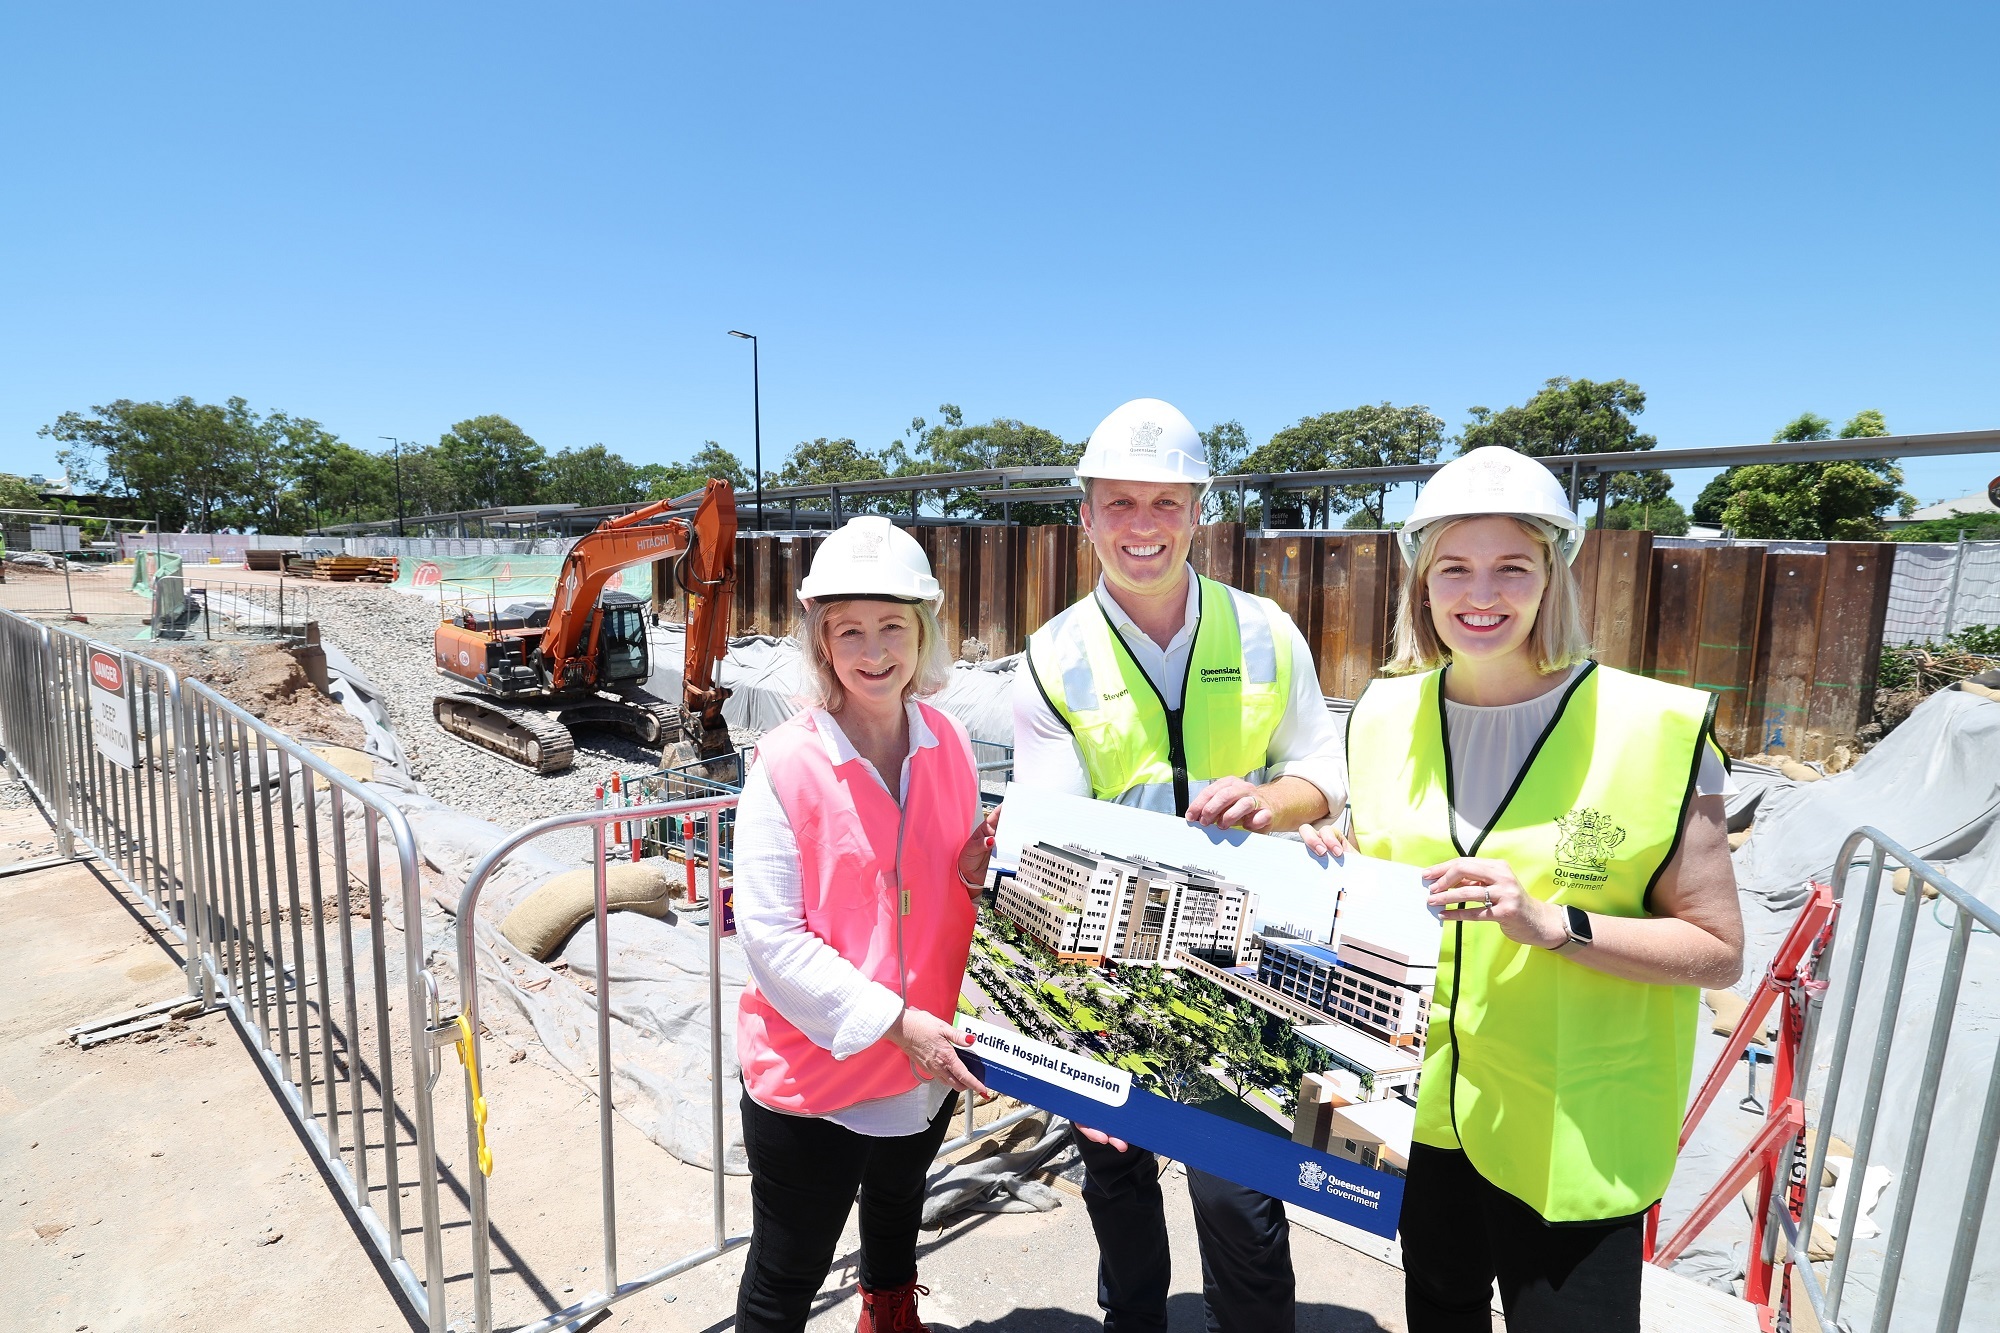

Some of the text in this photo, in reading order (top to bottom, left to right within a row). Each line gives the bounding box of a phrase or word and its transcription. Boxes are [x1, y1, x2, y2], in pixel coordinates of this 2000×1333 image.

[637, 534, 669, 551] HITACHI
[94, 660, 118, 684] DANGER
[1200, 667, 1241, 676] Queensland
[1200, 675, 1242, 683] Government
[1102, 688, 1129, 701] Steven
[102, 702, 116, 723] DEEP
[95, 718, 129, 751] EXCAVATION
[1552, 877, 1604, 891] Government
[1554, 868, 1609, 882] Queensland
[965, 1027, 1010, 1053] Rdcliffe
[1012, 1045, 1058, 1072] Hospital
[1060, 1062, 1121, 1094] Expansion
[1328, 1174, 1381, 1200] Queensland
[1326, 1184, 1379, 1210] Government
